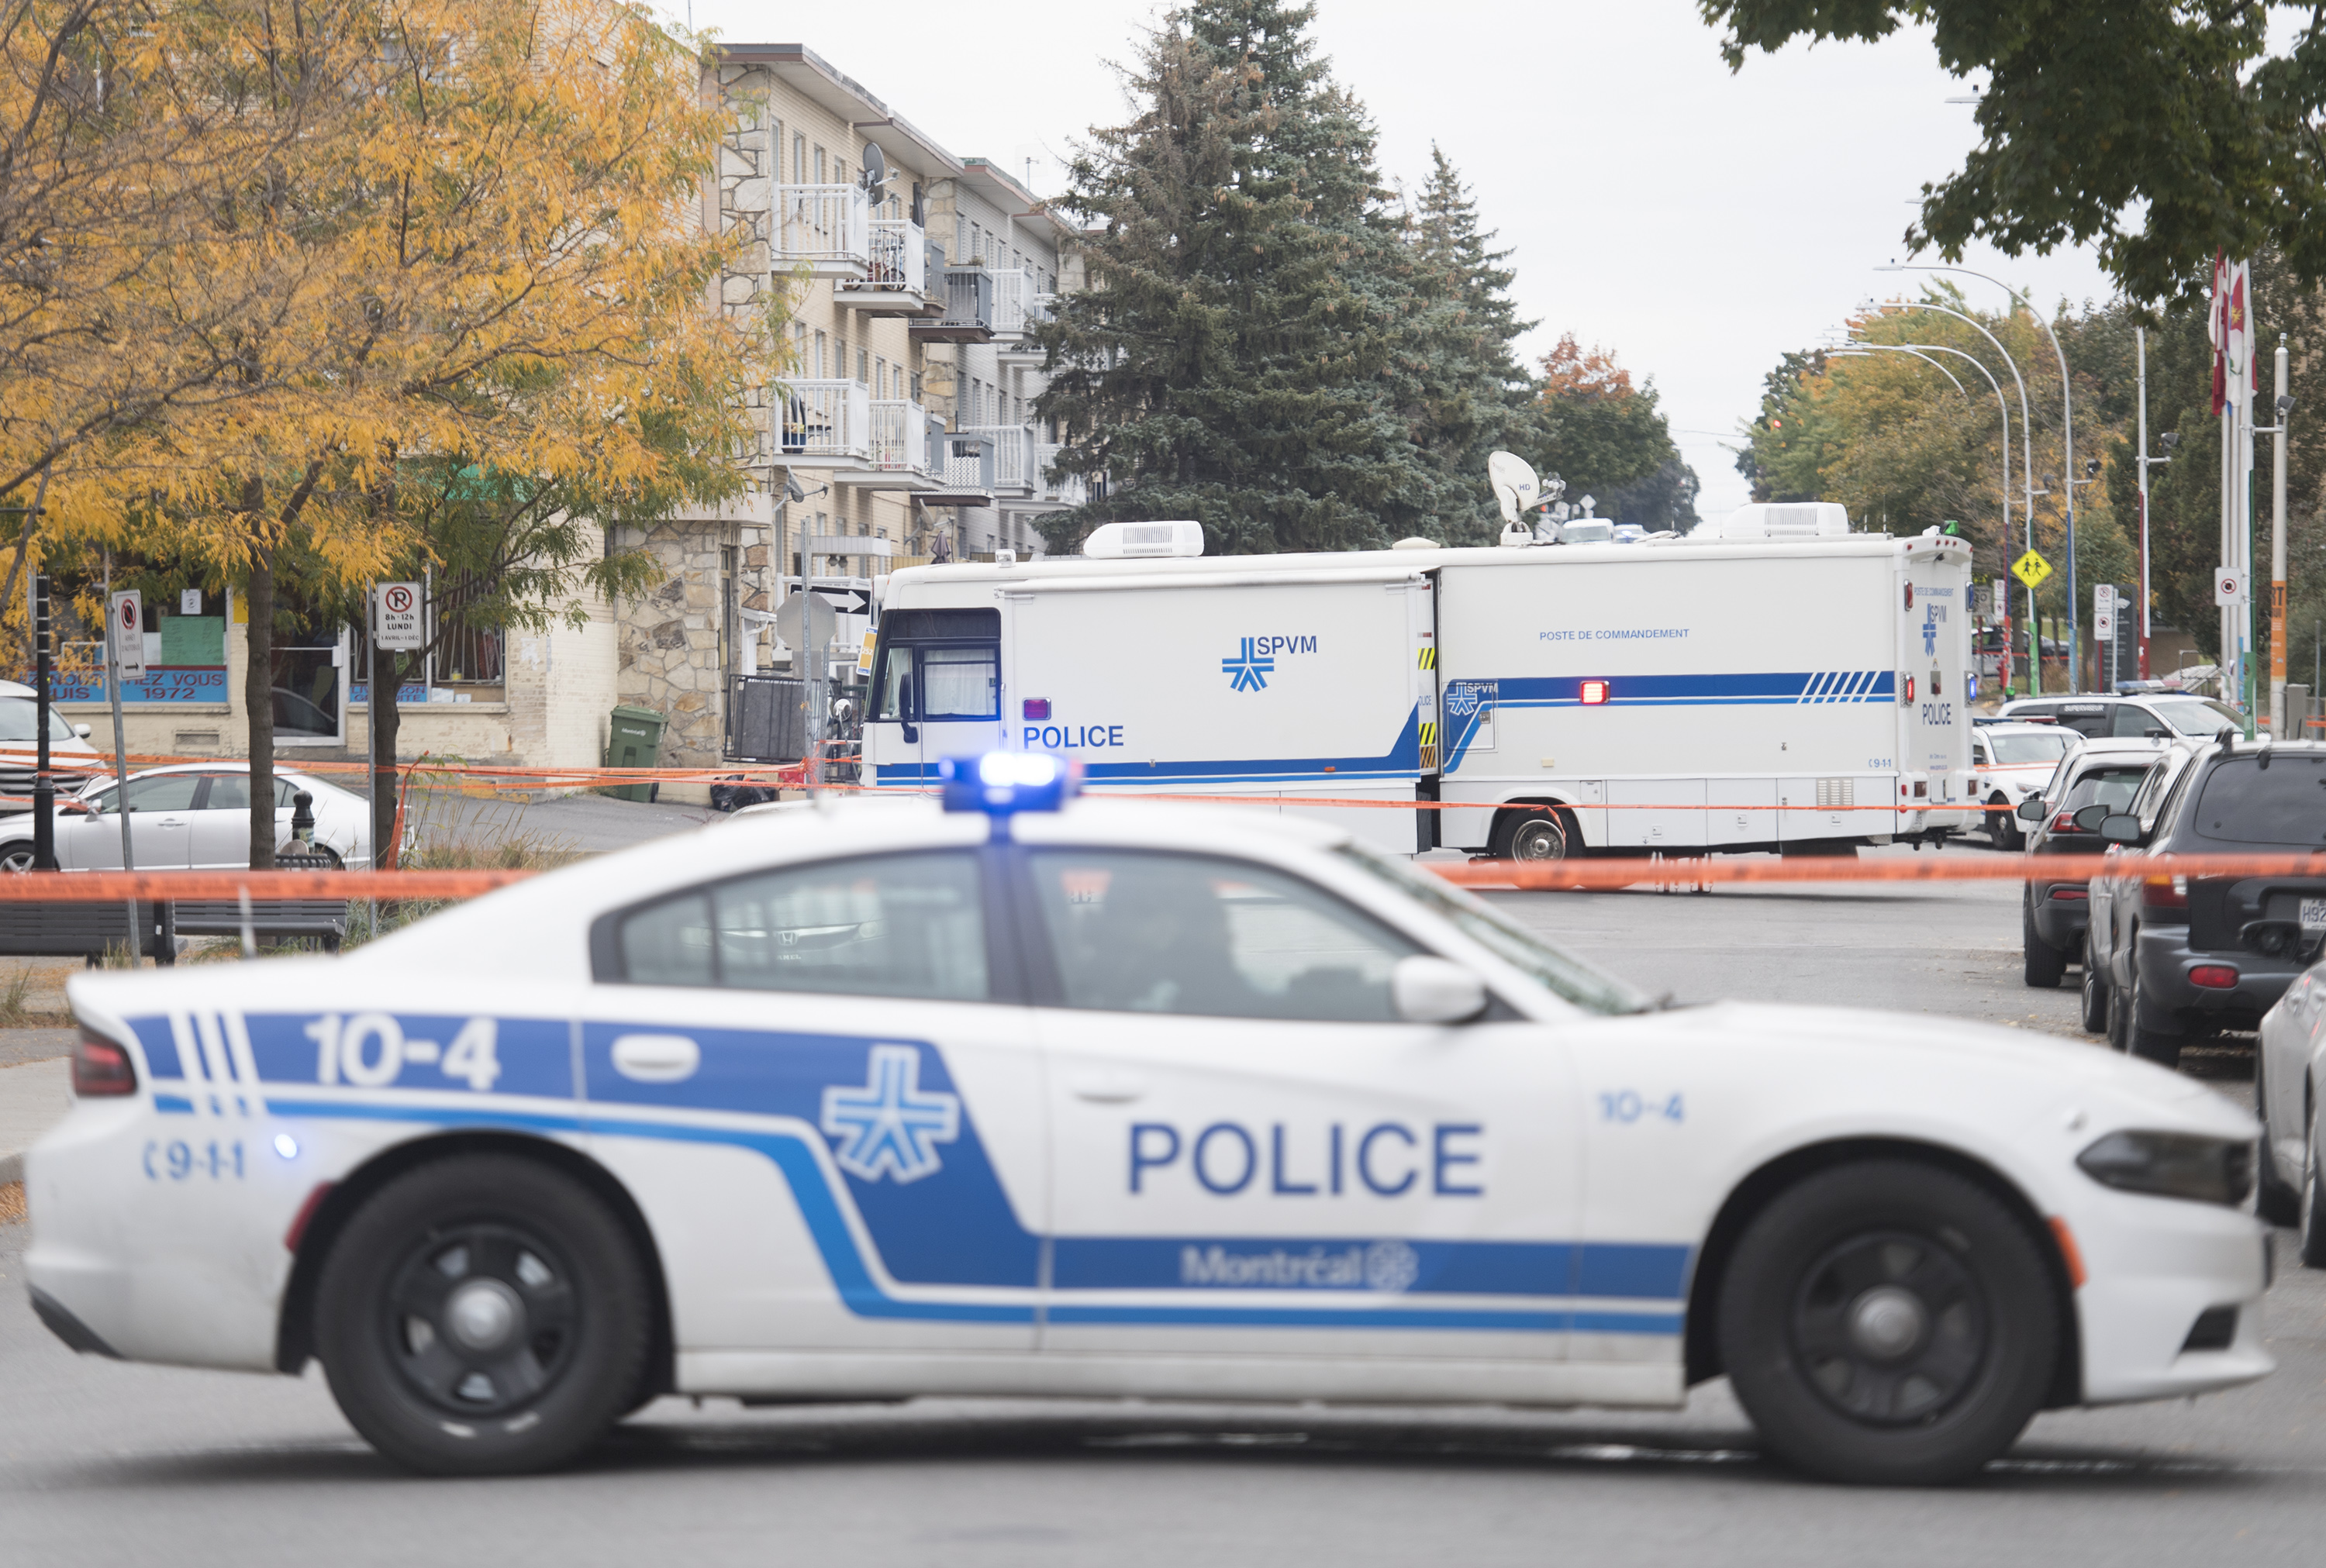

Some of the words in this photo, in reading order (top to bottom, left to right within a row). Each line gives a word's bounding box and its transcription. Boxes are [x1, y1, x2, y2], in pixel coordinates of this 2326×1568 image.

[1931, 605, 1947, 622] SPVM
[1540, 631, 1575, 640] POSTE
[1579, 631, 1593, 639] DE
[1596, 629, 1689, 639] COMMANDEMENT
[1257, 636, 1317, 655] SPVM
[173, 674, 223, 686] VOUS
[1467, 682, 1498, 693] SPVM
[141, 688, 195, 699] 1972
[1418, 694, 1431, 706] OLICE
[1923, 703, 1952, 725] POLICE
[1023, 725, 1124, 750] POLICE
[304, 1011, 501, 1092] 10-4
[1599, 1090, 1685, 1125] 10-4
[1128, 1122, 1486, 1198] POLICE
[1181, 1245, 1362, 1285] Montréal
